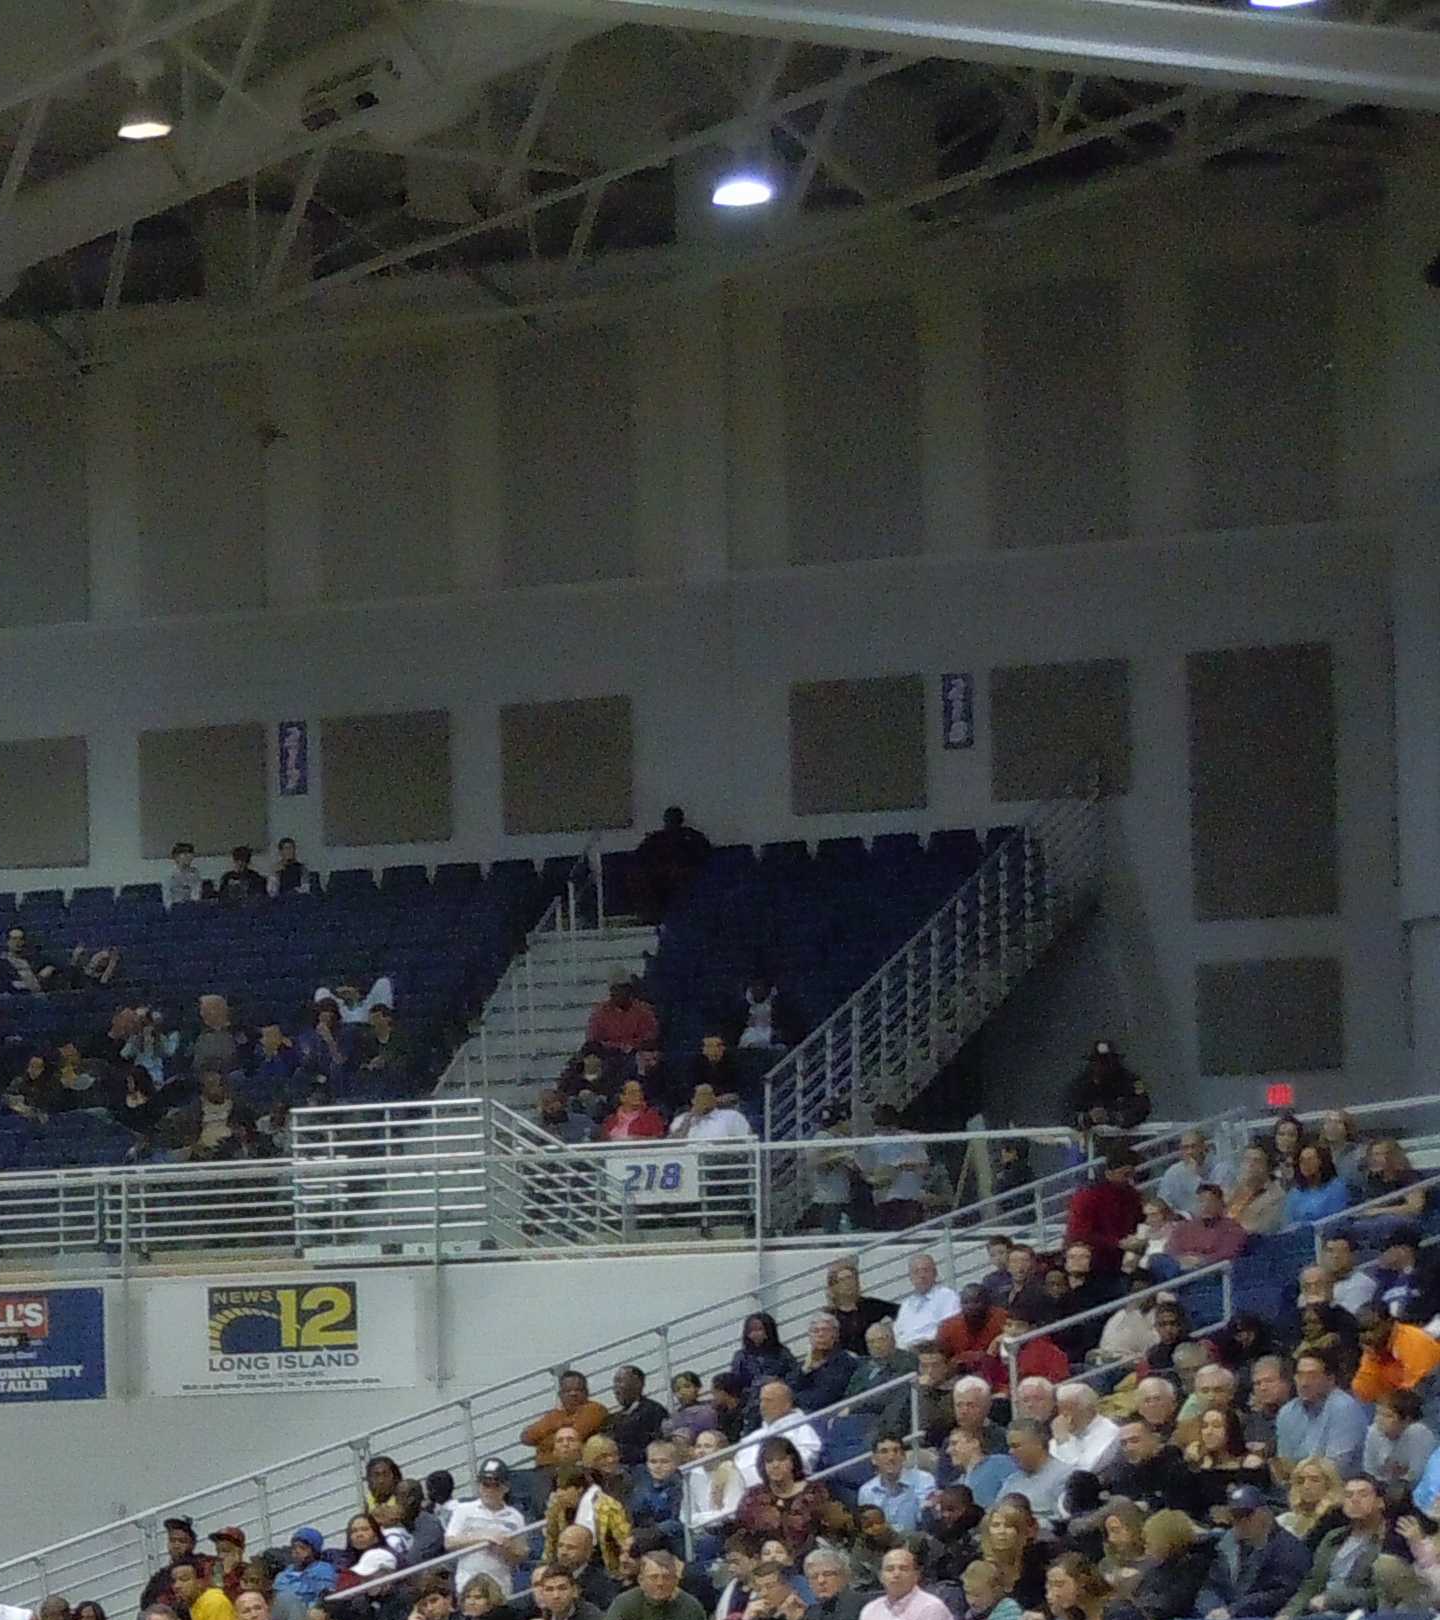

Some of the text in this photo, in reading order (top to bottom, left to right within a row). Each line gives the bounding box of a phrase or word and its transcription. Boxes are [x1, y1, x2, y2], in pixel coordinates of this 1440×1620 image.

[623, 1162, 682, 1191] 218
[213, 1286, 359, 1348] NEWS 12
[209, 1352, 359, 1372] LONG ISLAND
